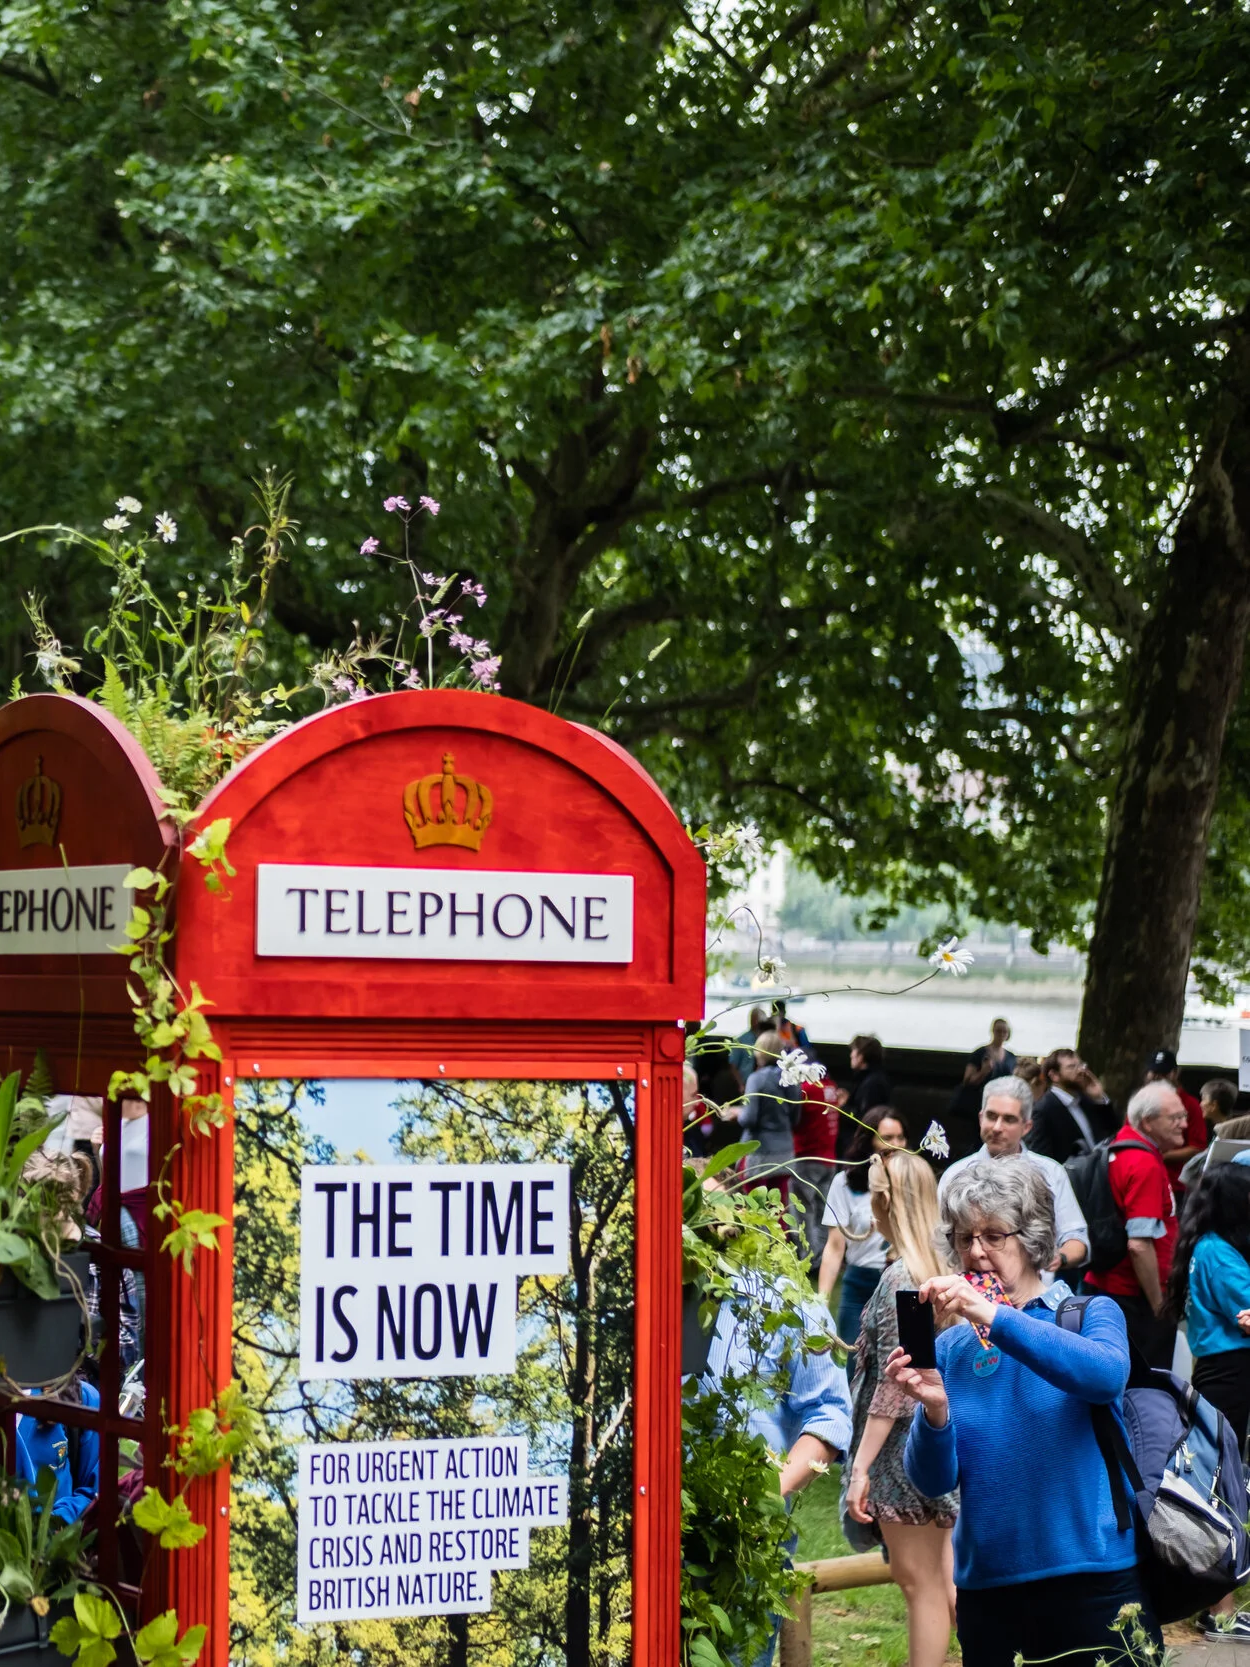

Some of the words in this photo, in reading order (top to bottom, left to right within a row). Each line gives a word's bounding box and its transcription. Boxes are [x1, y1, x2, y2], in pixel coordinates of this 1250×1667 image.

[285, 888, 610, 941] TELEPHONE
[314, 1181, 413, 1258] THE
[429, 1180, 554, 1256] TIME
[315, 1284, 359, 1363] IS
[376, 1282, 498, 1361] NOW
[310, 1454, 350, 1486] FOR
[357, 1449, 439, 1483] URGENT
[445, 1446, 518, 1480] ACTION
[309, 1495, 337, 1527] TO
[344, 1491, 420, 1525] TACKLE
[427, 1489, 466, 1521] THE
[472, 1485, 559, 1519] CLIMATE
[309, 1534, 373, 1569] CRISIS
[380, 1532, 422, 1566] AND
[429, 1527, 520, 1563] RESTORE
[309, 1575, 390, 1611] BRITISH
[397, 1570, 484, 1606] NATURE.
